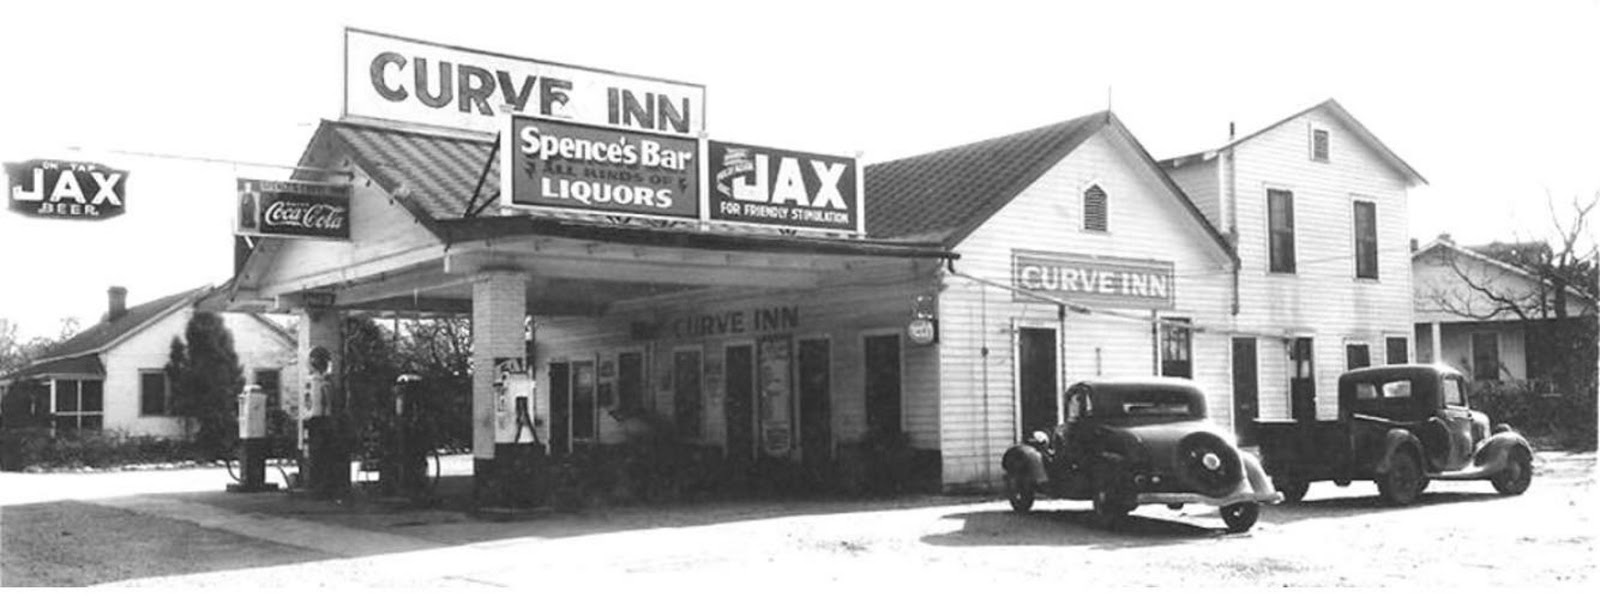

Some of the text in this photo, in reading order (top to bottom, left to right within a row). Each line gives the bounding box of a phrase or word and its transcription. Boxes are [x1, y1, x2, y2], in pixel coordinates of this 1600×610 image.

[369, 50, 690, 133] CURVE INN
[520, 125, 692, 170] Spence's Bar
[69, 162, 96, 173] TAP
[543, 161, 673, 185] ALL KINDS OF
[731, 153, 848, 209] JAX
[12, 167, 122, 206] JAX
[541, 177, 673, 208] LIQUORS
[720, 201, 849, 224] FOR FRIENDLY STIMULATION
[1020, 265, 1168, 298] CURVE INN
[674, 311, 744, 338] CURVE
[755, 306, 799, 330] INN
